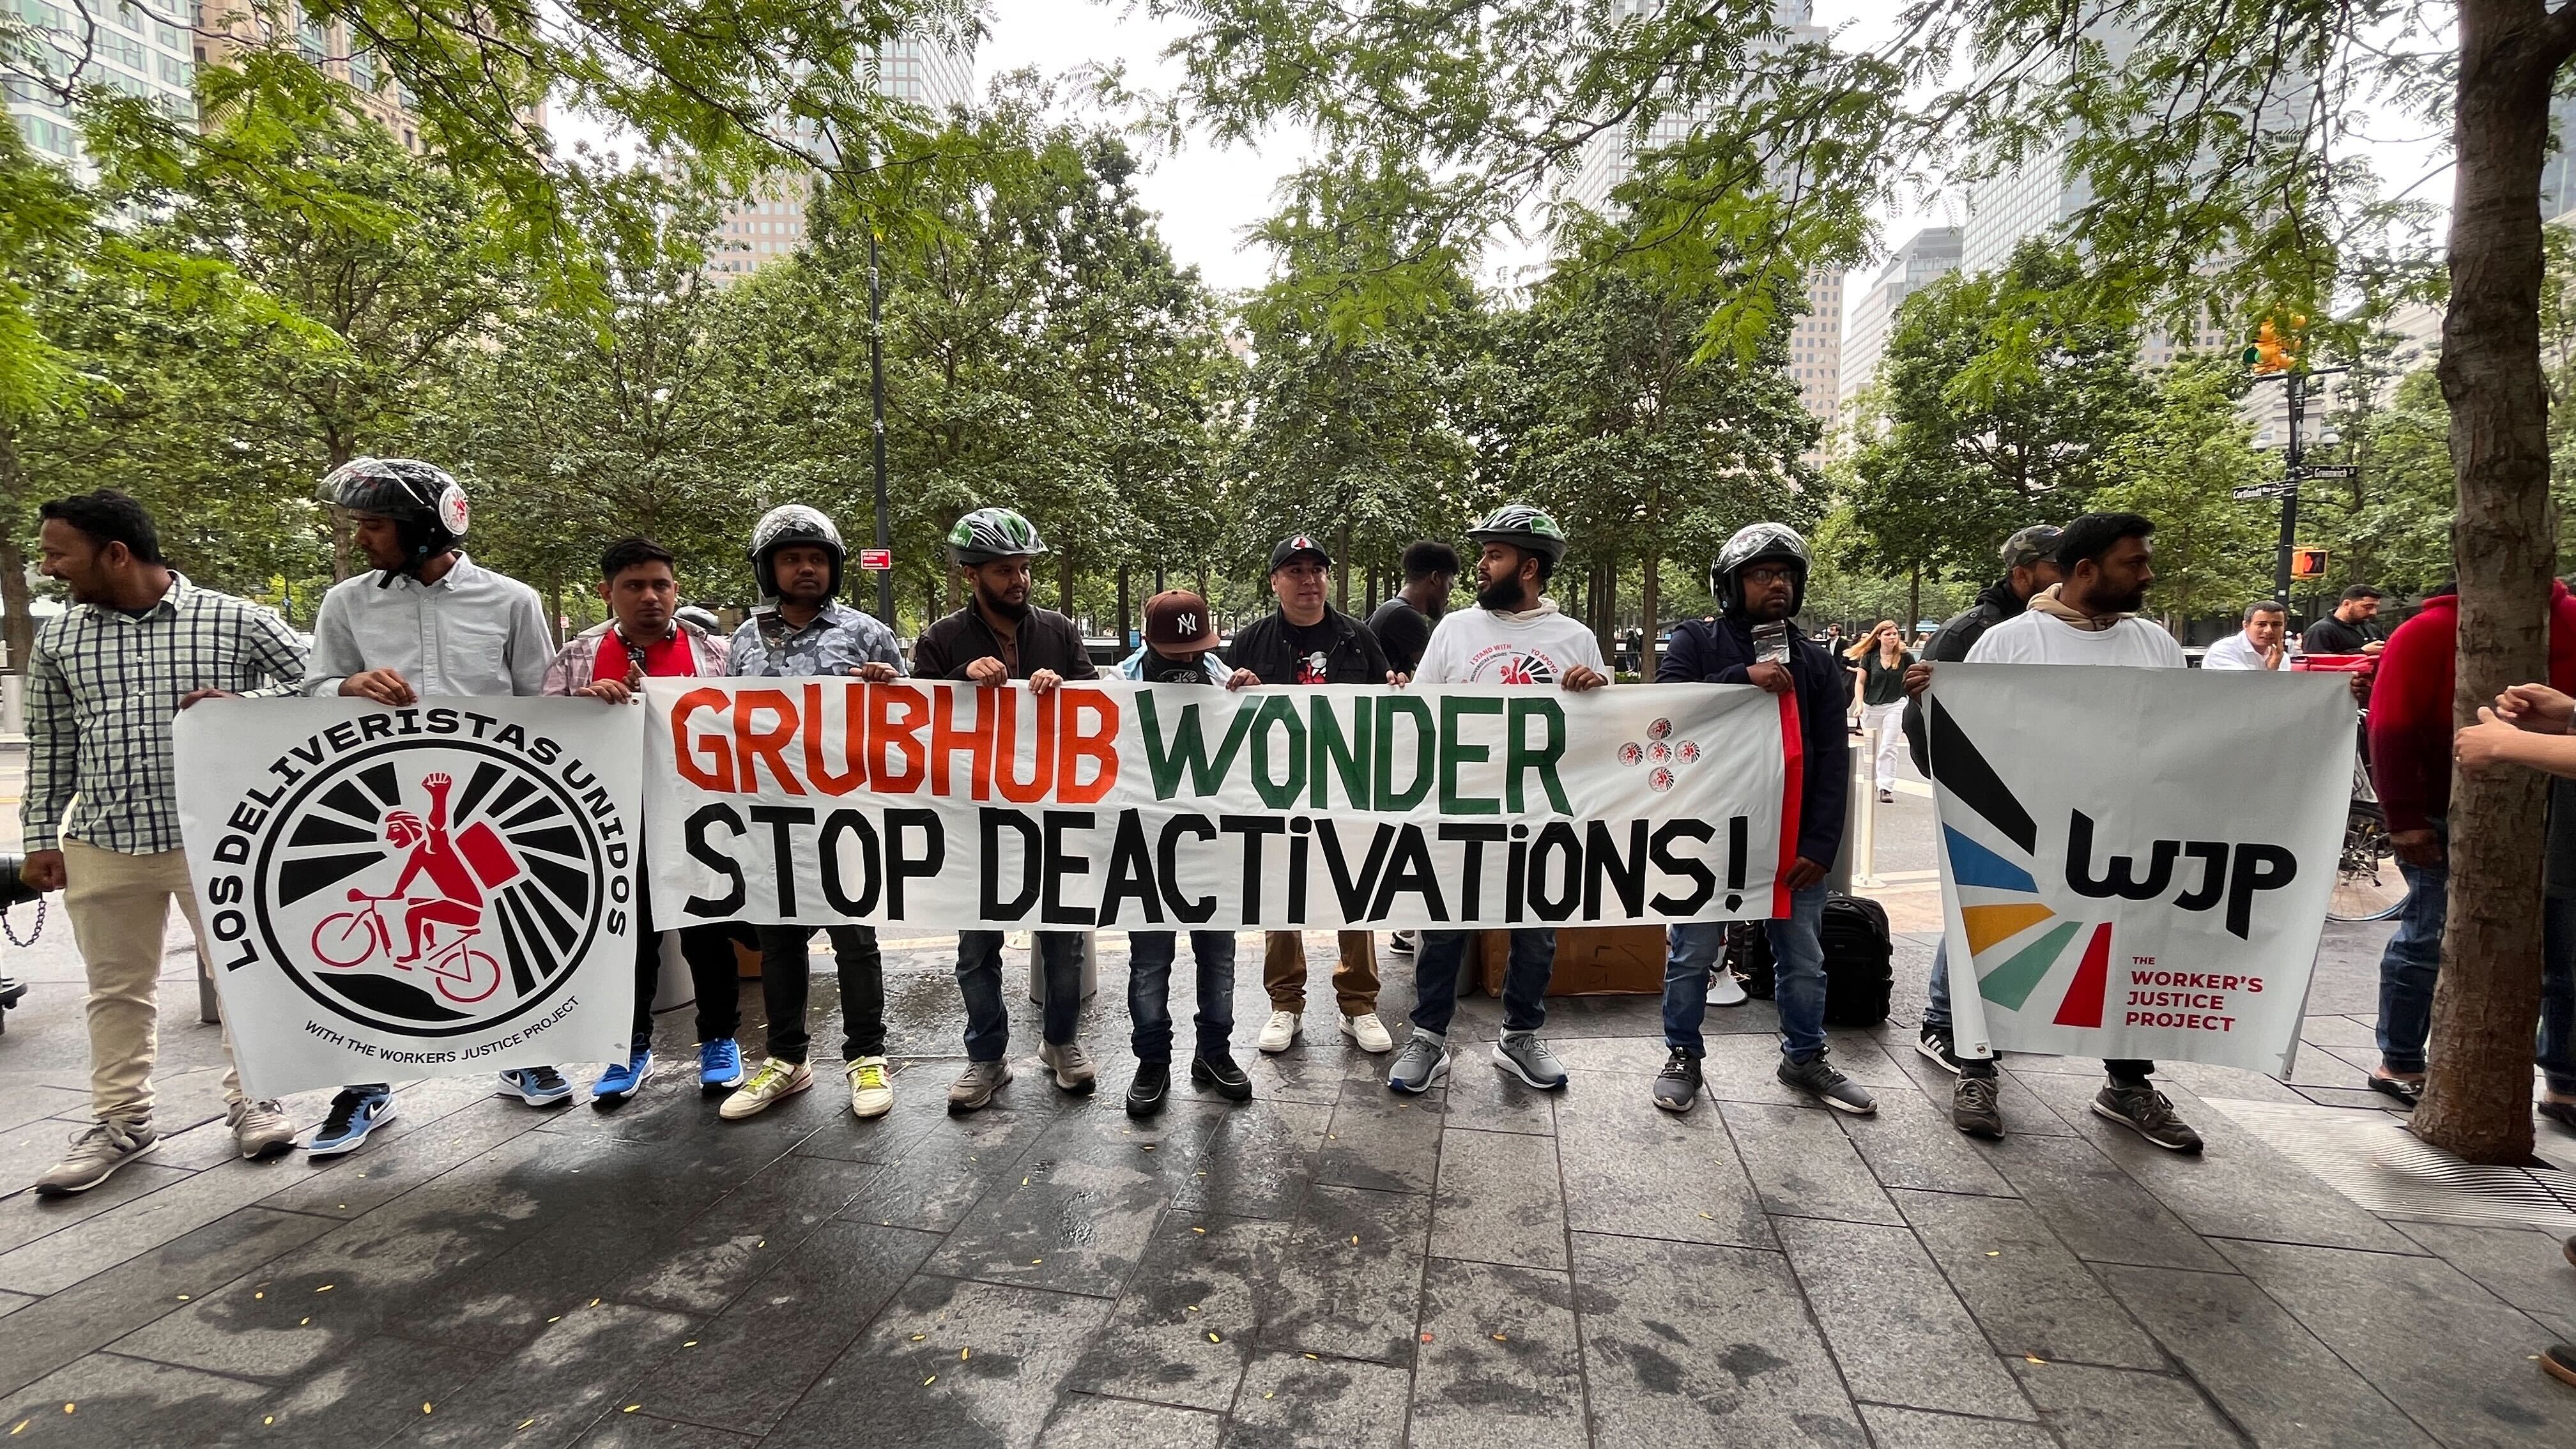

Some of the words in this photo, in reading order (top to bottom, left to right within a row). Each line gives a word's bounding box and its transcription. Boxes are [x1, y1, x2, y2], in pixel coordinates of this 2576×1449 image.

[1177, 613, 1197, 635] NY
[1473, 647, 1493, 663] STAND
[1531, 648, 1540, 656] YO
[1539, 654, 1559, 674] APOYO
[671, 684, 1119, 803] GRUBHUB
[1135, 689, 1574, 818] WONDER
[213, 709, 562, 867] DELIVERISTAS
[562, 758, 630, 938] UNIDOS
[683, 802, 945, 921] STOP
[2066, 808, 2297, 941] WJP
[208, 875, 260, 972] LOS
[2131, 970, 2264, 993] WORKER'S
[2132, 956, 2155, 965] THE
[2125, 1011, 2235, 1032] PROJECT
[2127, 991, 2224, 1010] JUSTICE
[305, 1020, 344, 1046] WITH
[348, 1038, 377, 1057] THE
[380, 1048, 456, 1064] WORKERS
[461, 1032, 523, 1061] JUSTICE
[524, 995, 579, 1039] PROJECT
